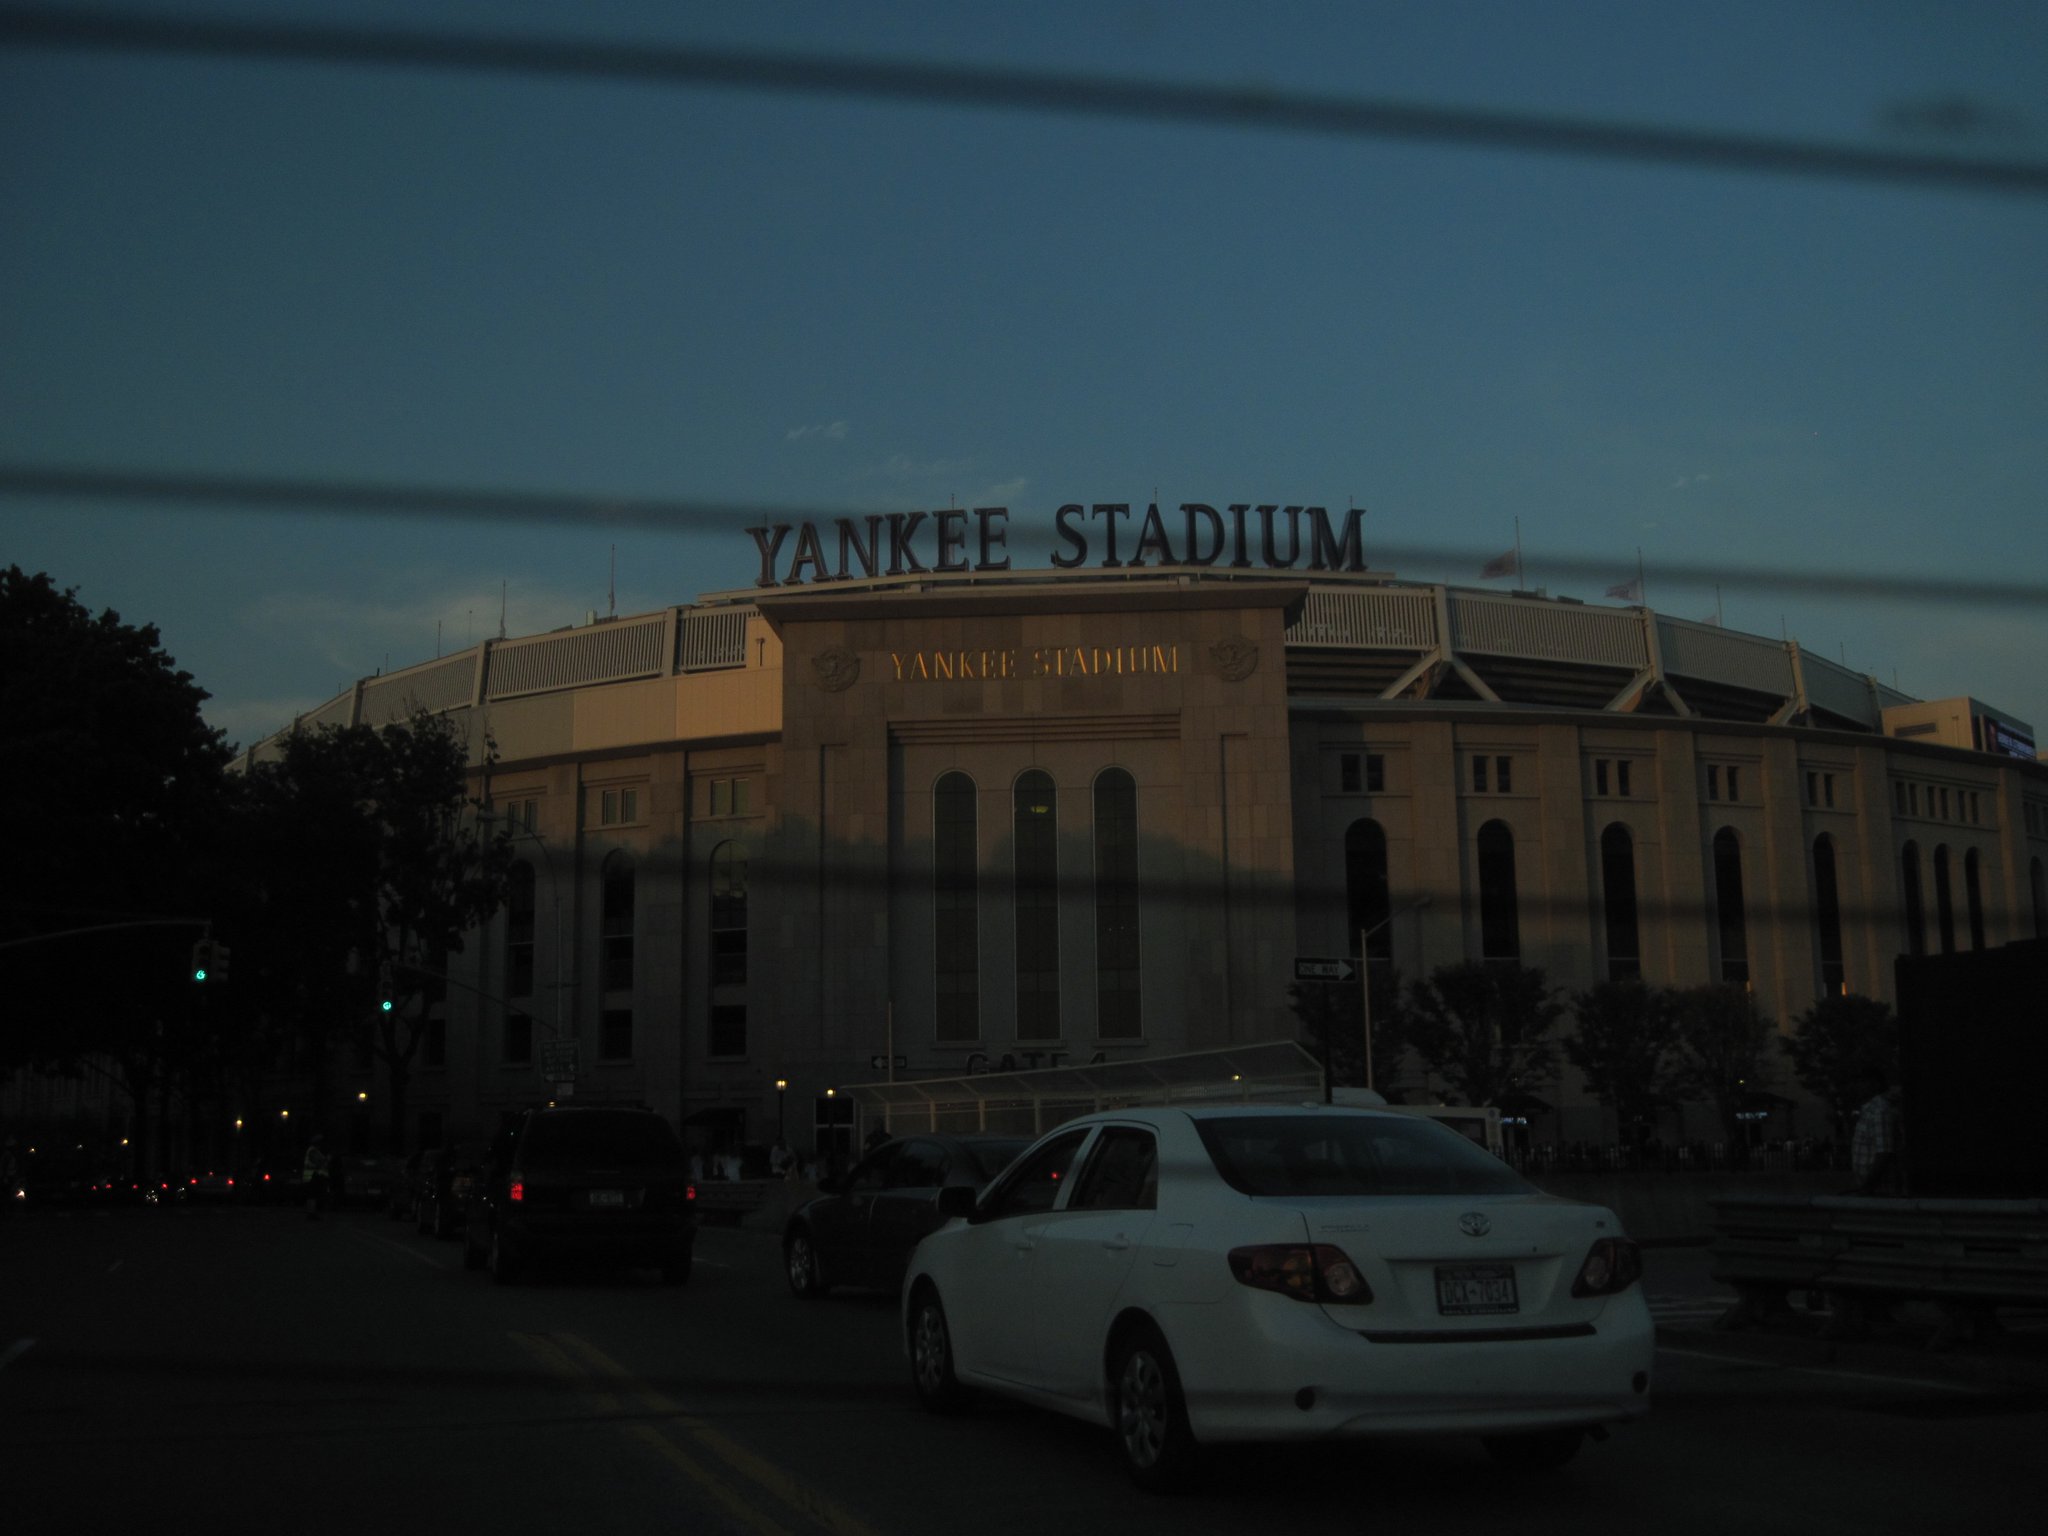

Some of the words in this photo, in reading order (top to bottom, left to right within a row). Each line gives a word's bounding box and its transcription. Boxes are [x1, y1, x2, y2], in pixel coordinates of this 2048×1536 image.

[746, 507, 1011, 588] YANKEE
[1050, 502, 1368, 572] STADIUM
[891, 649, 1016, 681] YANKEE
[1032, 644, 1179, 677] STADIUM
[1299, 963, 1316, 975] ONE
[1321, 964, 1339, 975] WAY
[967, 1051, 1071, 1076] GATE
